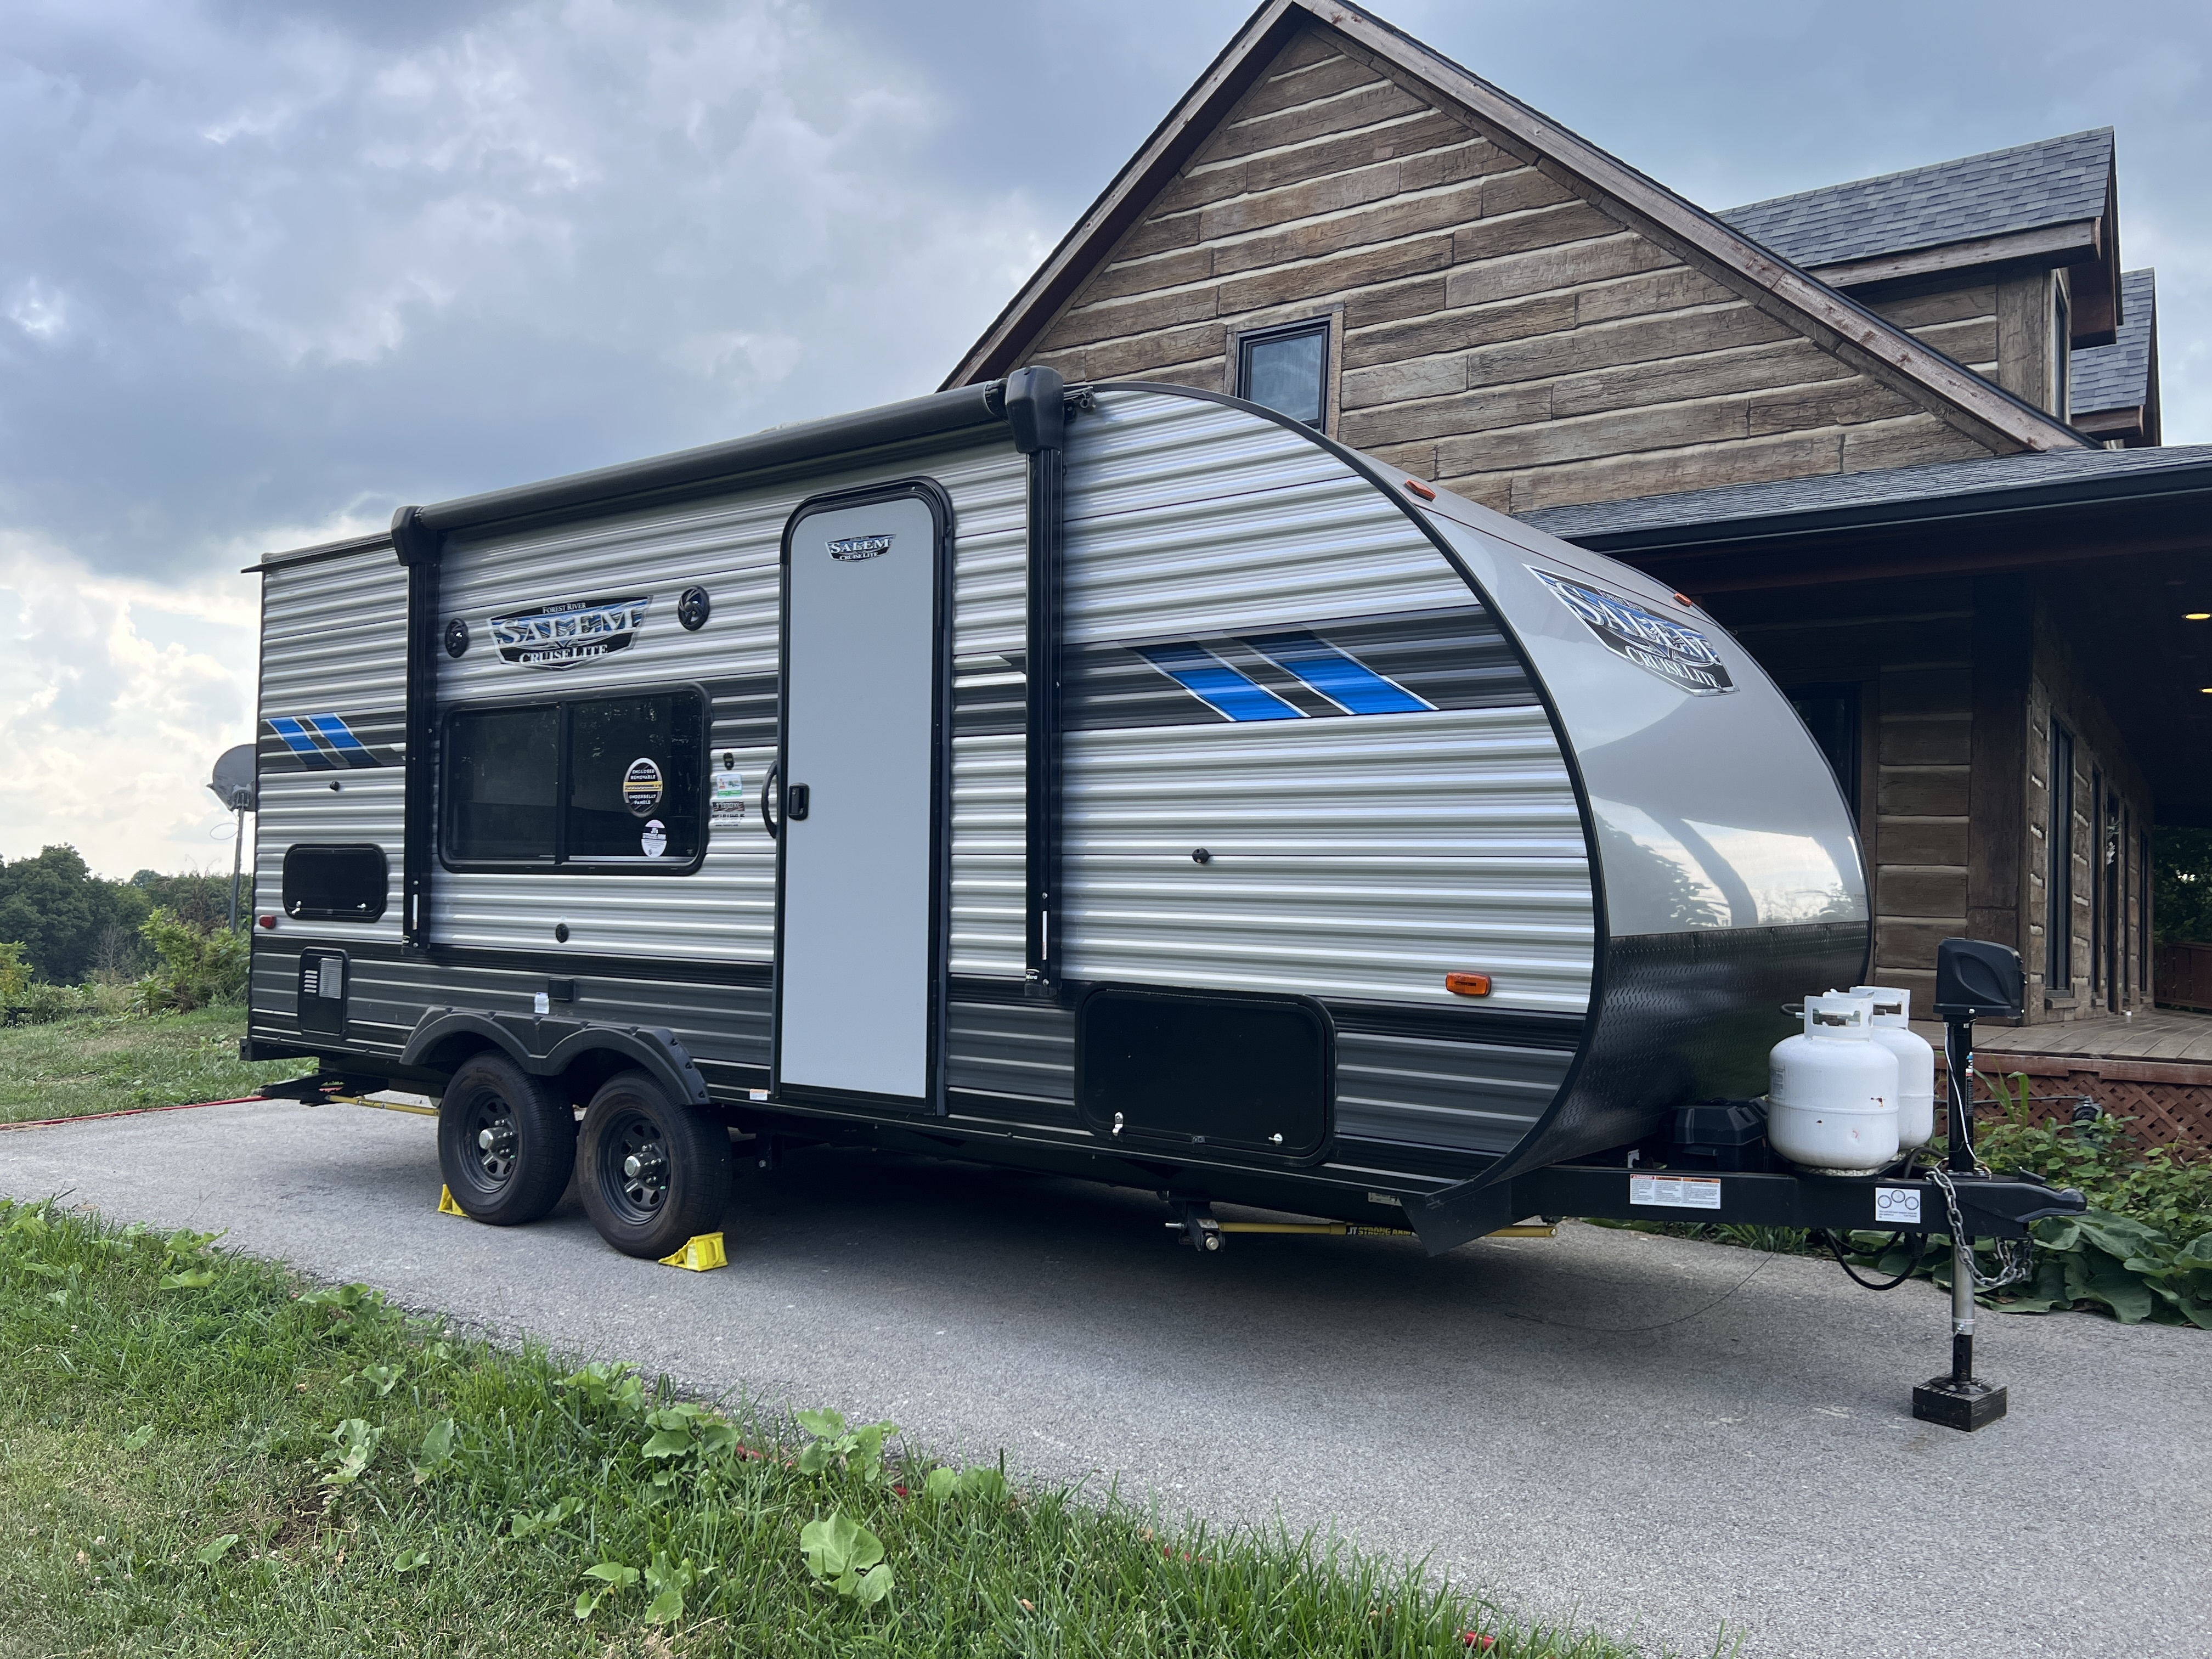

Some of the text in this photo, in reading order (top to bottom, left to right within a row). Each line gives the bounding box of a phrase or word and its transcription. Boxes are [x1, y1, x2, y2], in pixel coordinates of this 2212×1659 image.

[831, 539, 890, 553] SALEM
[542, 605, 566, 614] FOREST
[497, 608, 639, 646] SALEM
[1556, 580, 1723, 666] SALEM
[1347, 1226, 1357, 1235] JT
[1358, 1226, 1391, 1235] STRONG
